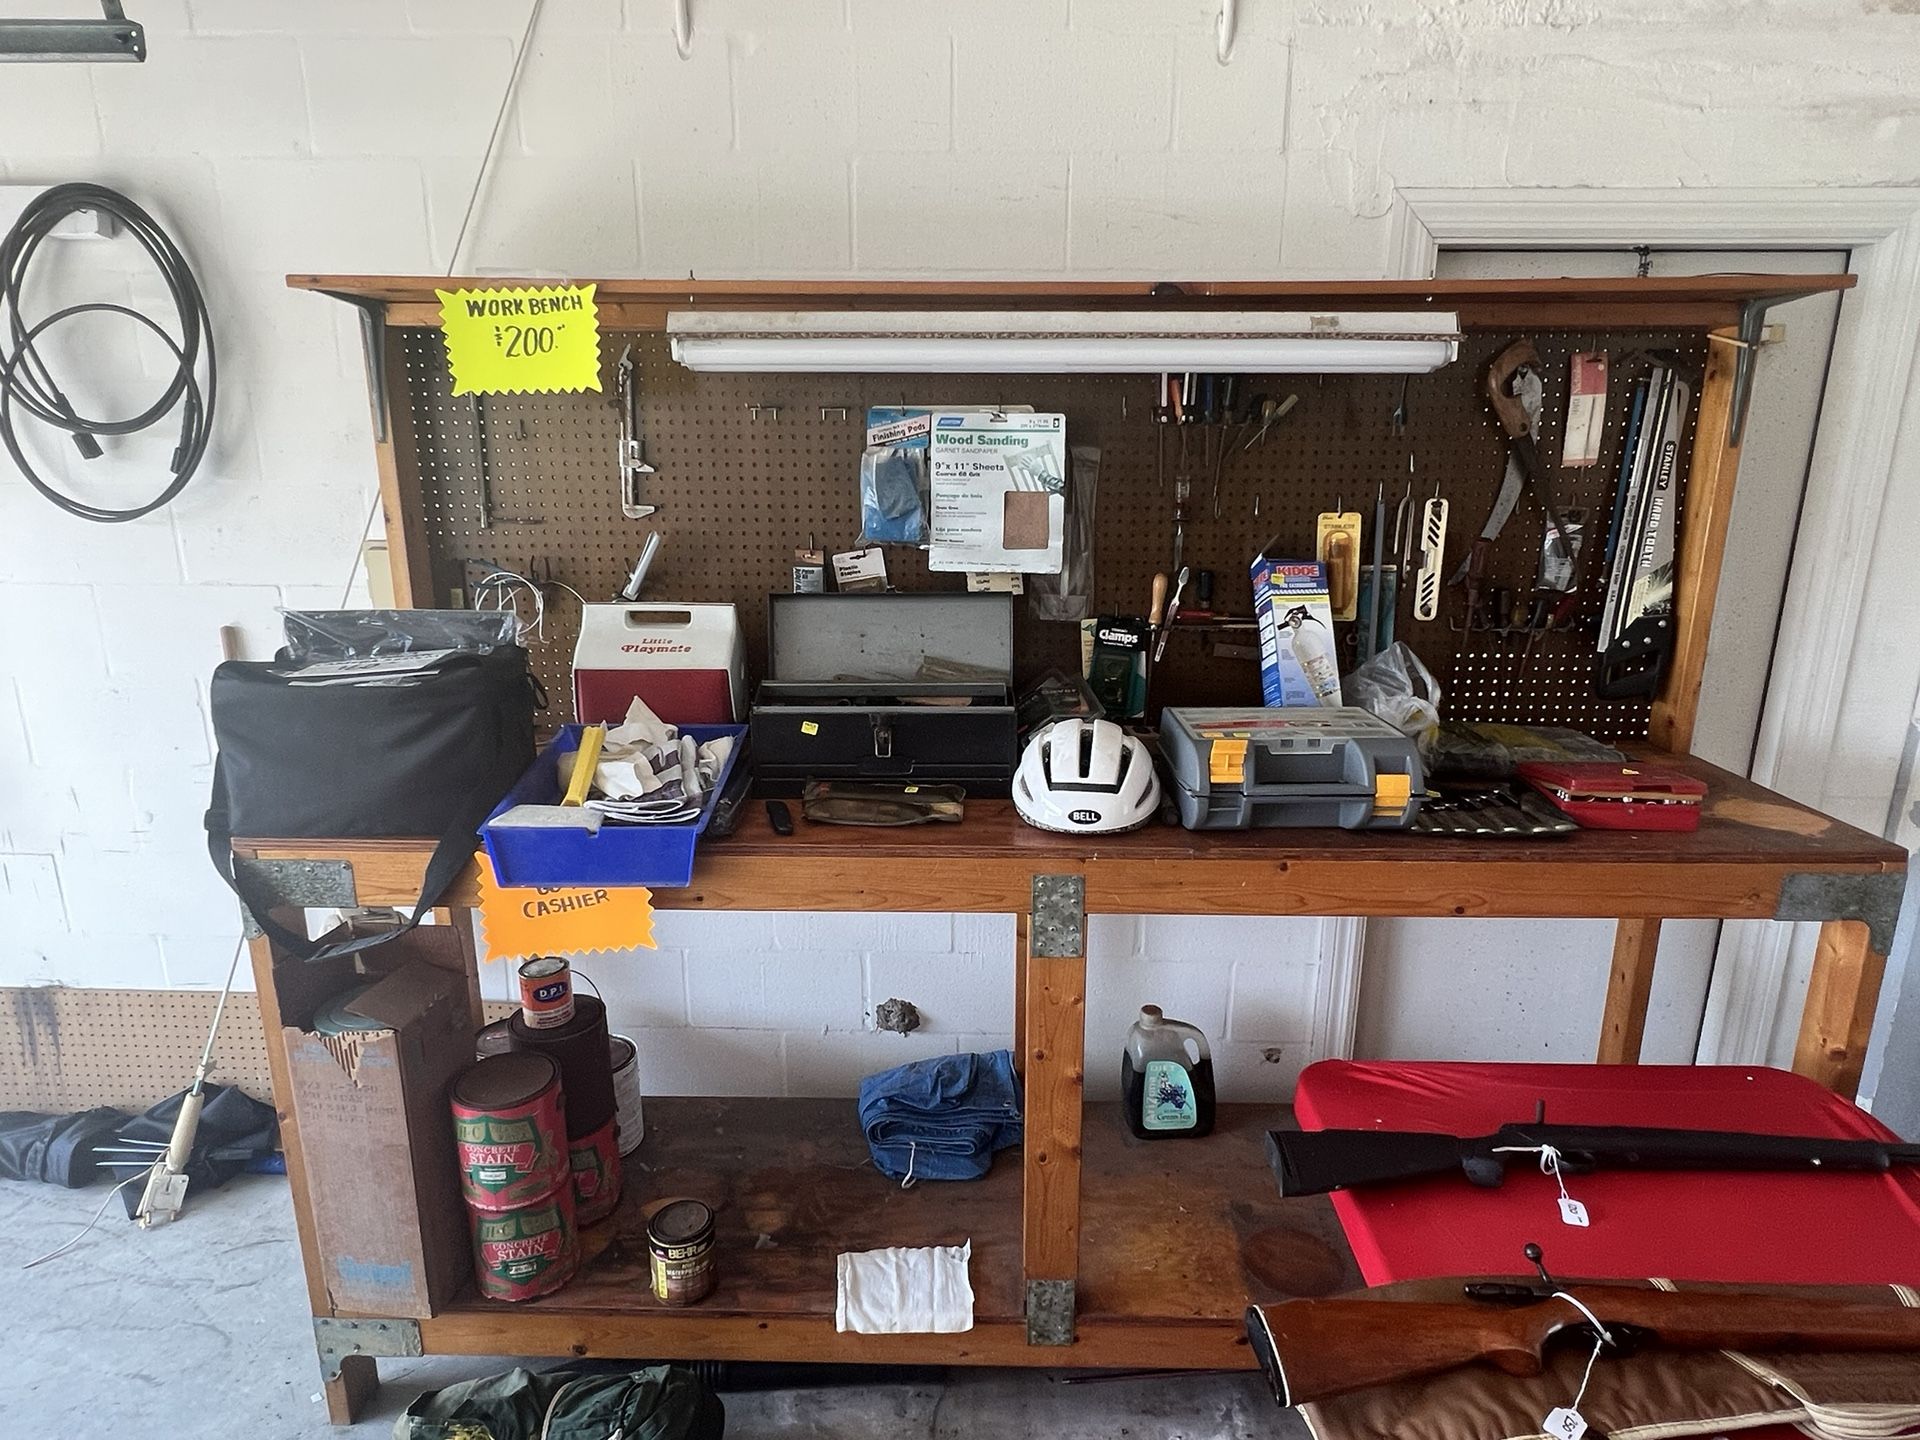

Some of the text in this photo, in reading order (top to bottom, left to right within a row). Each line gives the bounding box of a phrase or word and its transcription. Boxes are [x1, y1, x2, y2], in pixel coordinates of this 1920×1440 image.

[465, 295, 583, 318] WORK BENCH
[872, 429, 906, 443] Finishing
[936, 434, 973, 445] Wood
[977, 435, 1029, 448] Sanding
[972, 462, 1004, 471] Sheets
[1641, 443, 1675, 568] STANLEY HARD TOOTH
[1276, 565, 1319, 577] KIDDE
[1099, 629, 1138, 644] Clamps
[621, 645, 692, 655] Playmate
[1073, 811, 1098, 821] BELL
[523, 889, 610, 918] CASHIER
[464, 1144, 521, 1154] CONCRETE
[469, 1152, 516, 1164] STAIN
[492, 1234, 549, 1251] CONCRETE
[497, 1244, 545, 1260] STAIN
[668, 1245, 697, 1259] BEHR
